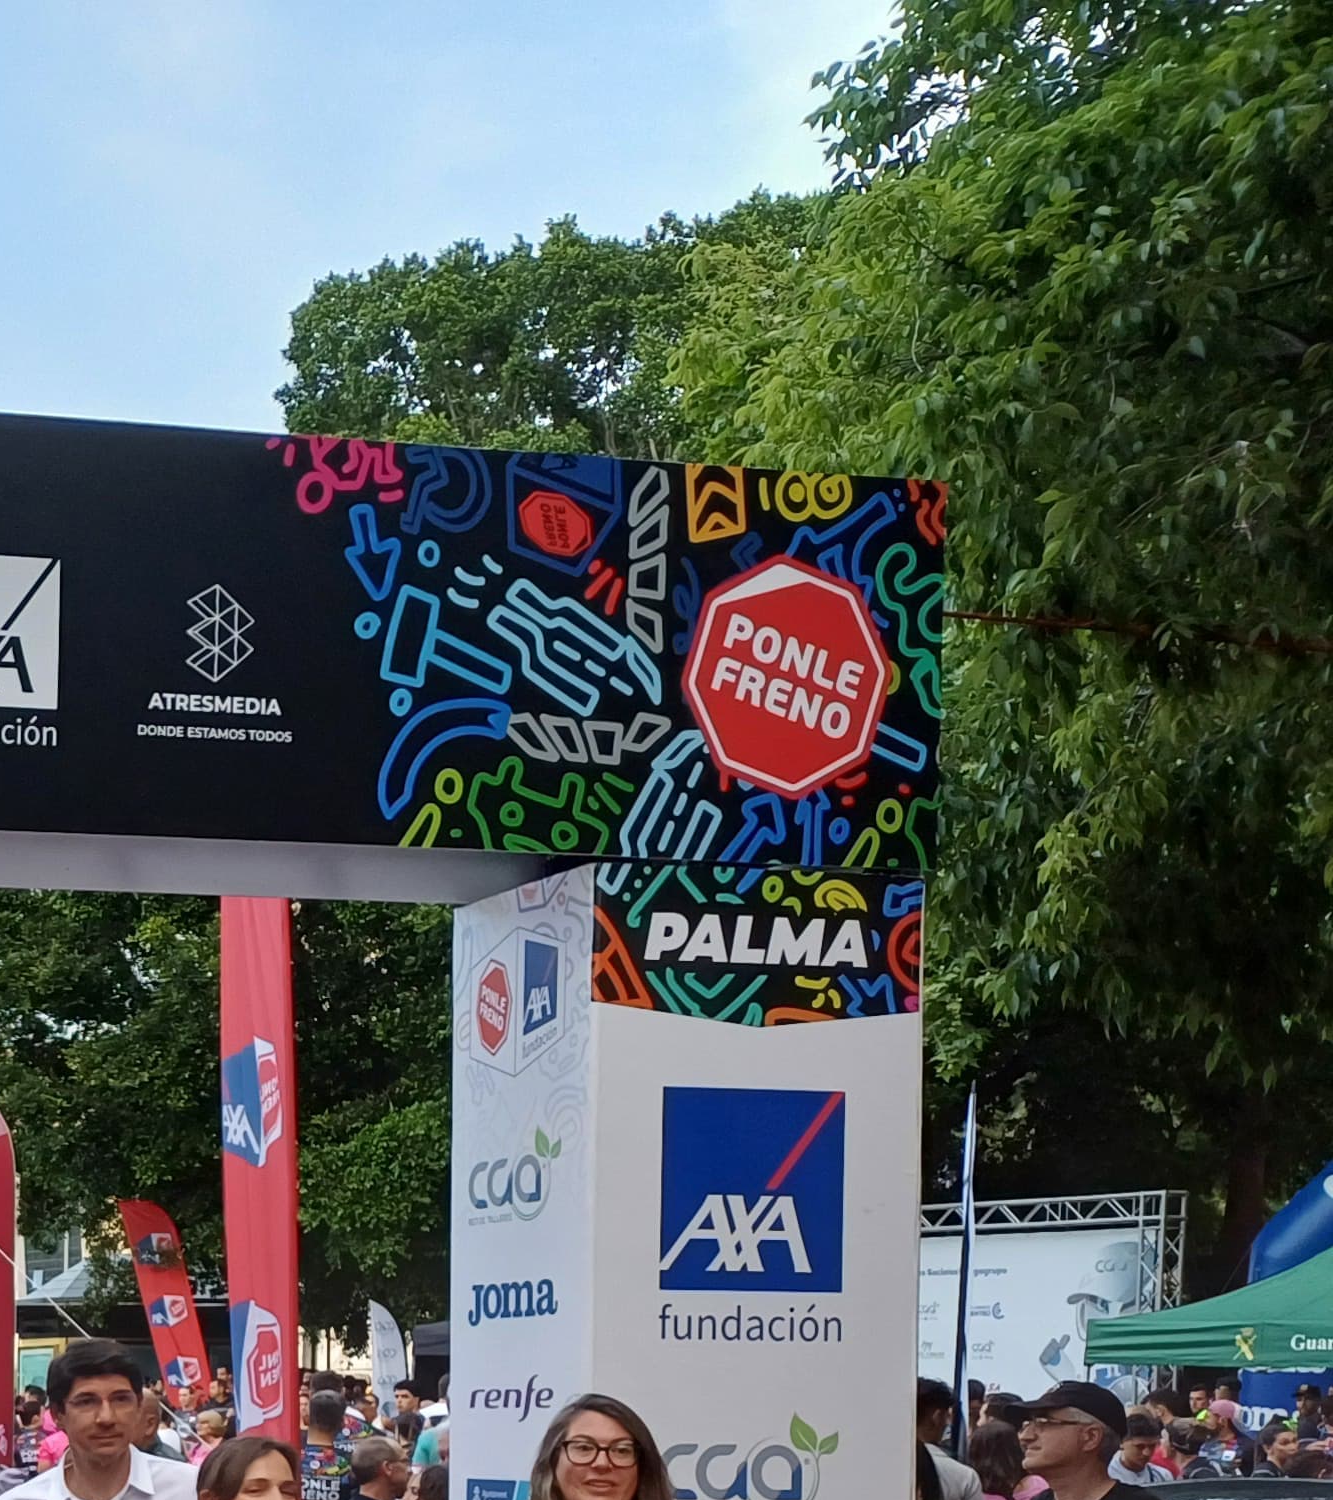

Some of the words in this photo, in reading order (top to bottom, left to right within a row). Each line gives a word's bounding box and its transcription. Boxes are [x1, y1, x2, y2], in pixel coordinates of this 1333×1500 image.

[722, 612, 867, 701] PONLE
[147, 691, 282, 718] ATRESMEDIA
[710, 656, 854, 741] FRENO
[136, 722, 185, 740] DONDE
[187, 725, 247, 743] ESTAMOS
[248, 728, 294, 745] TODOS
[643, 910, 871, 970] PALMA
[660, 1193, 813, 1274] AXA
[658, 1303, 844, 1343] fundación
[469, 1373, 554, 1424] renfe
[301, 1478, 340, 1491] ONLE
